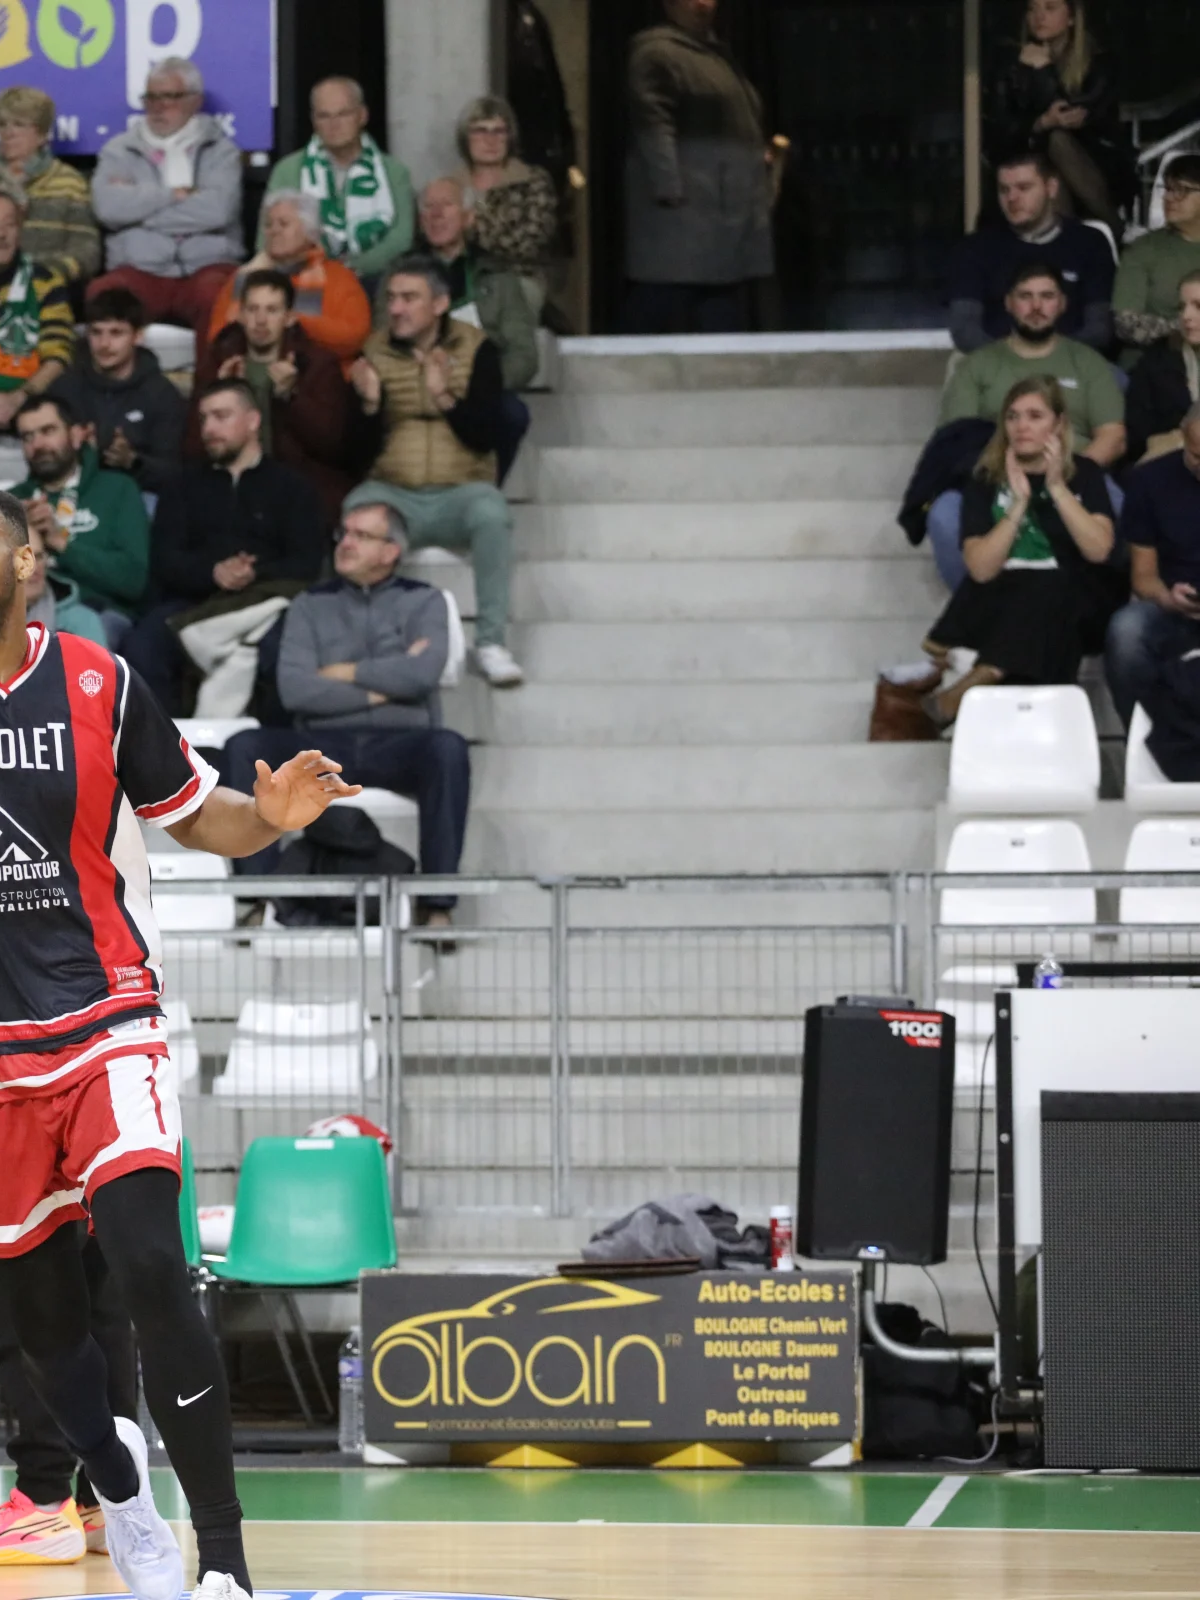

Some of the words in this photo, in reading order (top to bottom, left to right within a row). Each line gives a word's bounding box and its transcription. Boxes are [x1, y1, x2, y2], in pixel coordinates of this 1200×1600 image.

[78, 675, 104, 687] CHOLET
[698, 1279, 834, 1303] Auto-Ecoles
[694, 1317, 768, 1334] BOULOGNE
[769, 1316, 818, 1334] Chemin
[819, 1317, 848, 1334] Vert
[704, 1340, 782, 1357] BOULOGNE
[786, 1340, 838, 1357] Daunou
[733, 1363, 755, 1380] Le
[757, 1362, 811, 1381] Portel
[737, 1385, 808, 1403] Outreau
[705, 1409, 746, 1426] Pont
[749, 1409, 771, 1426] de
[773, 1408, 840, 1430] Briques
